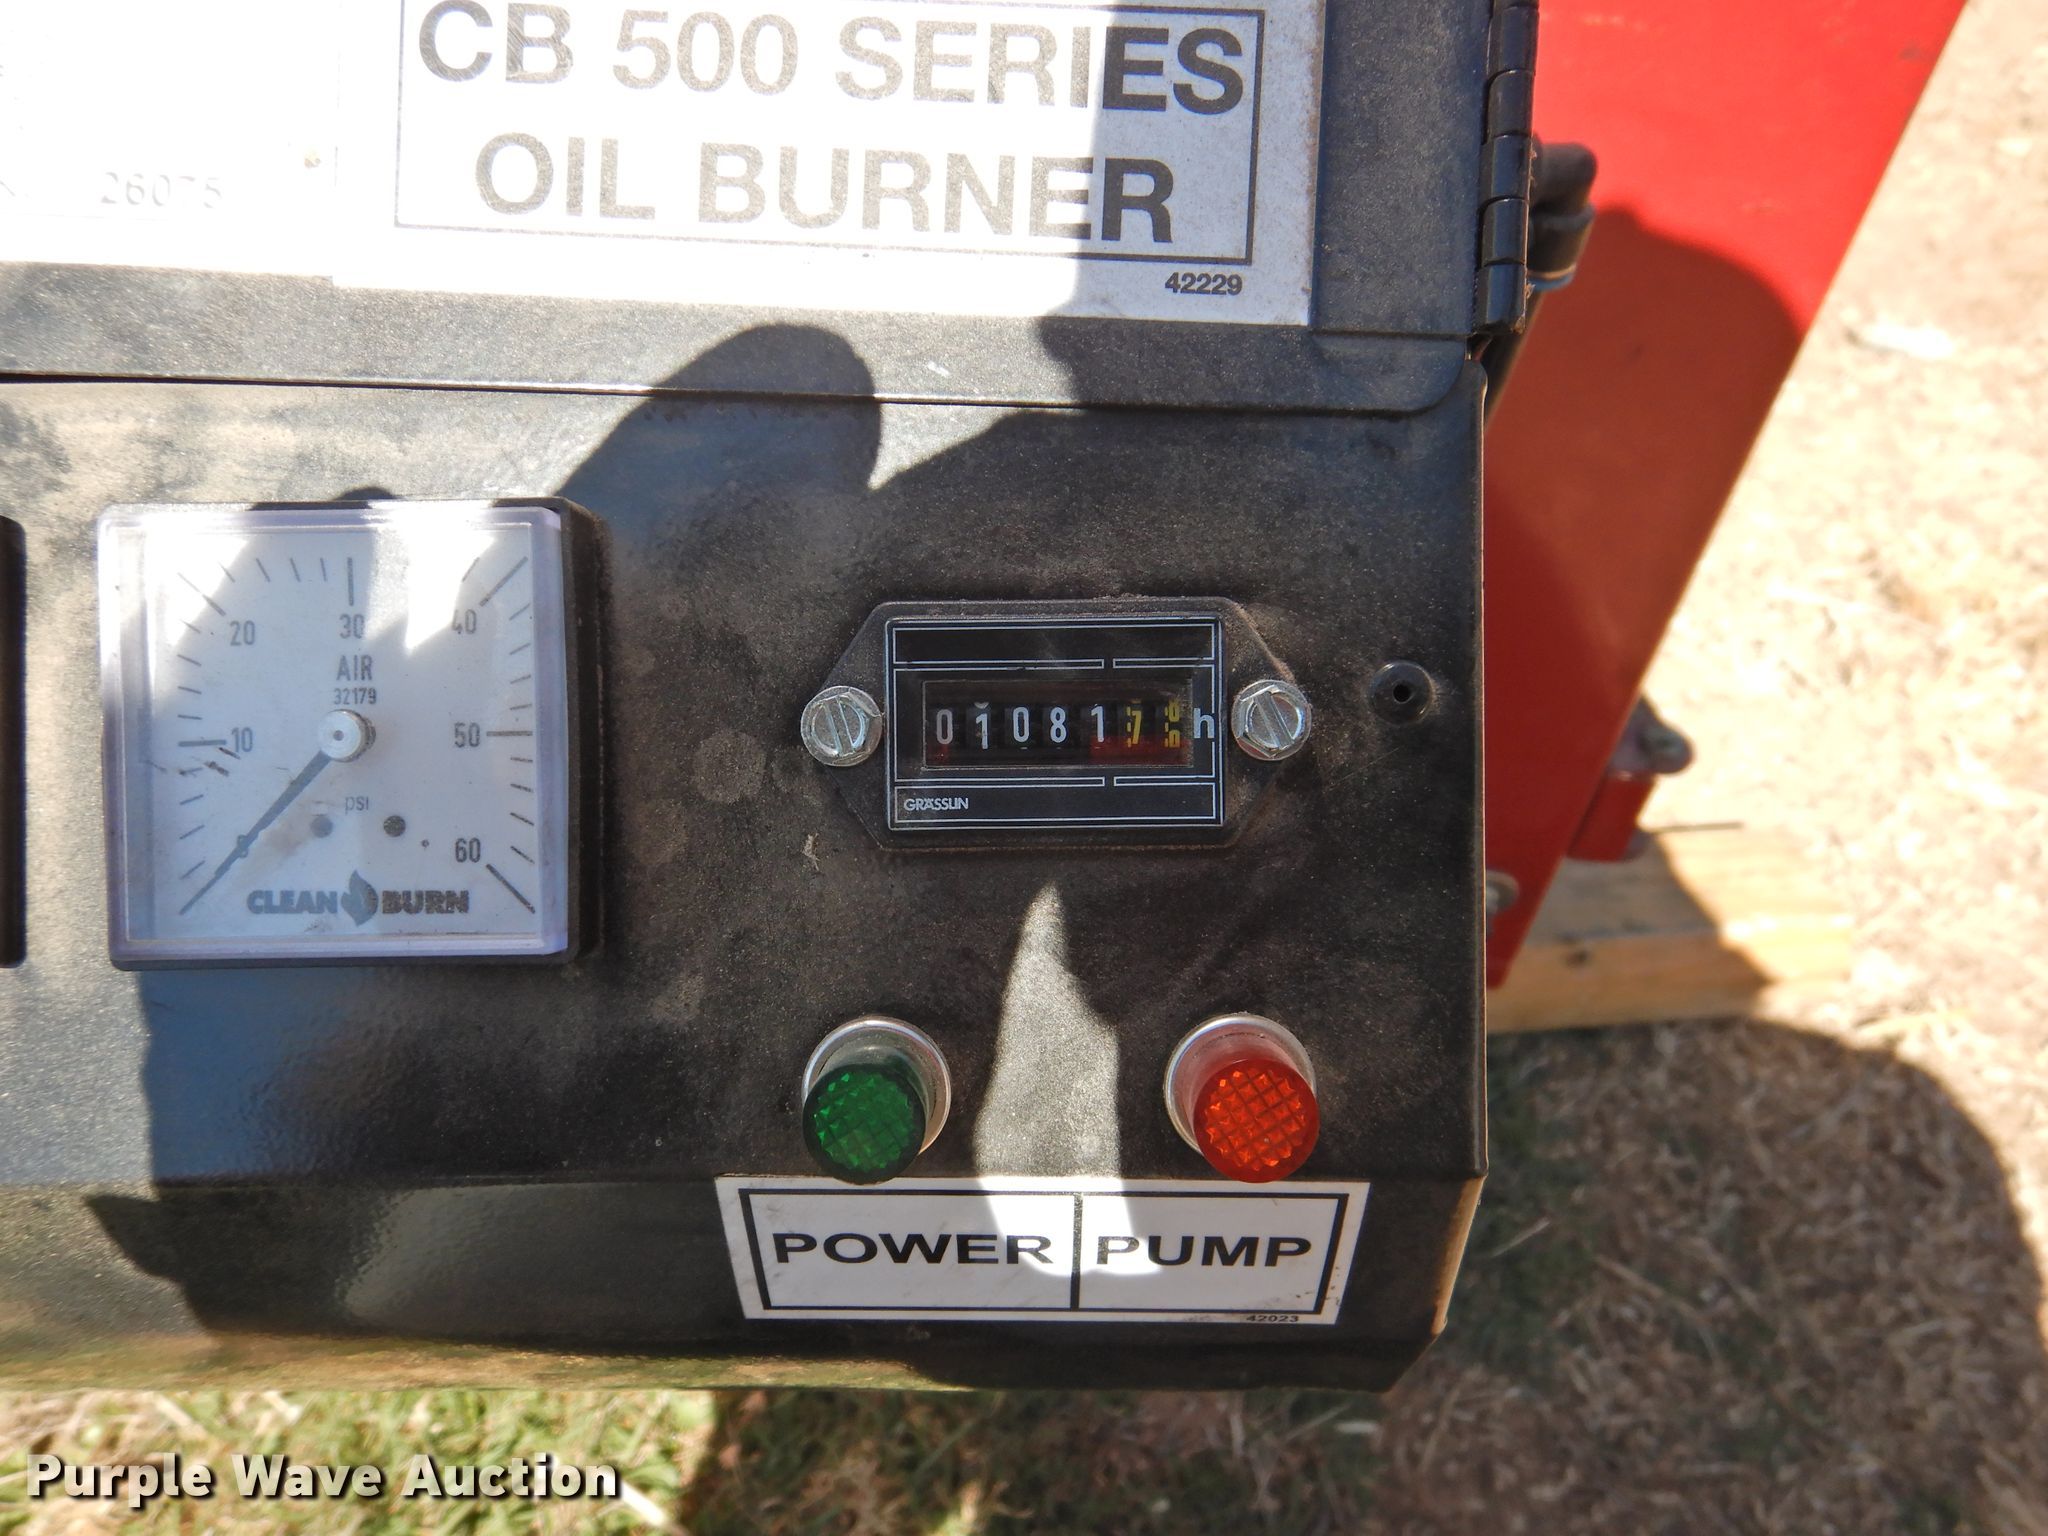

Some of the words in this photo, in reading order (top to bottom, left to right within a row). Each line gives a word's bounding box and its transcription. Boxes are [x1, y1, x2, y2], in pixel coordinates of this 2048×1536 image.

[418, 0, 574, 84] CB
[612, 9, 798, 95] 500
[834, 16, 1244, 114] SERIES
[475, 132, 656, 220] OIL
[698, 142, 1173, 244] BURNER
[1165, 272, 1243, 296] 42229
[230, 620, 256, 646] 20
[339, 613, 365, 639] 30
[451, 609, 477, 635] 40
[336, 654, 373, 681] AIR
[333, 687, 377, 705] 32179
[454, 722, 481, 749] 50
[1193, 707, 1215, 739] h
[231, 727, 254, 752] 10
[344, 796, 369, 816] psi
[455, 838, 481, 864] 60
[247, 890, 338, 914] CLEAN
[382, 890, 469, 914] BURN
[772, 1232, 1052, 1265] POWER
[1096, 1234, 1311, 1267] PUMP
[1246, 1315, 1299, 1323] 42023
